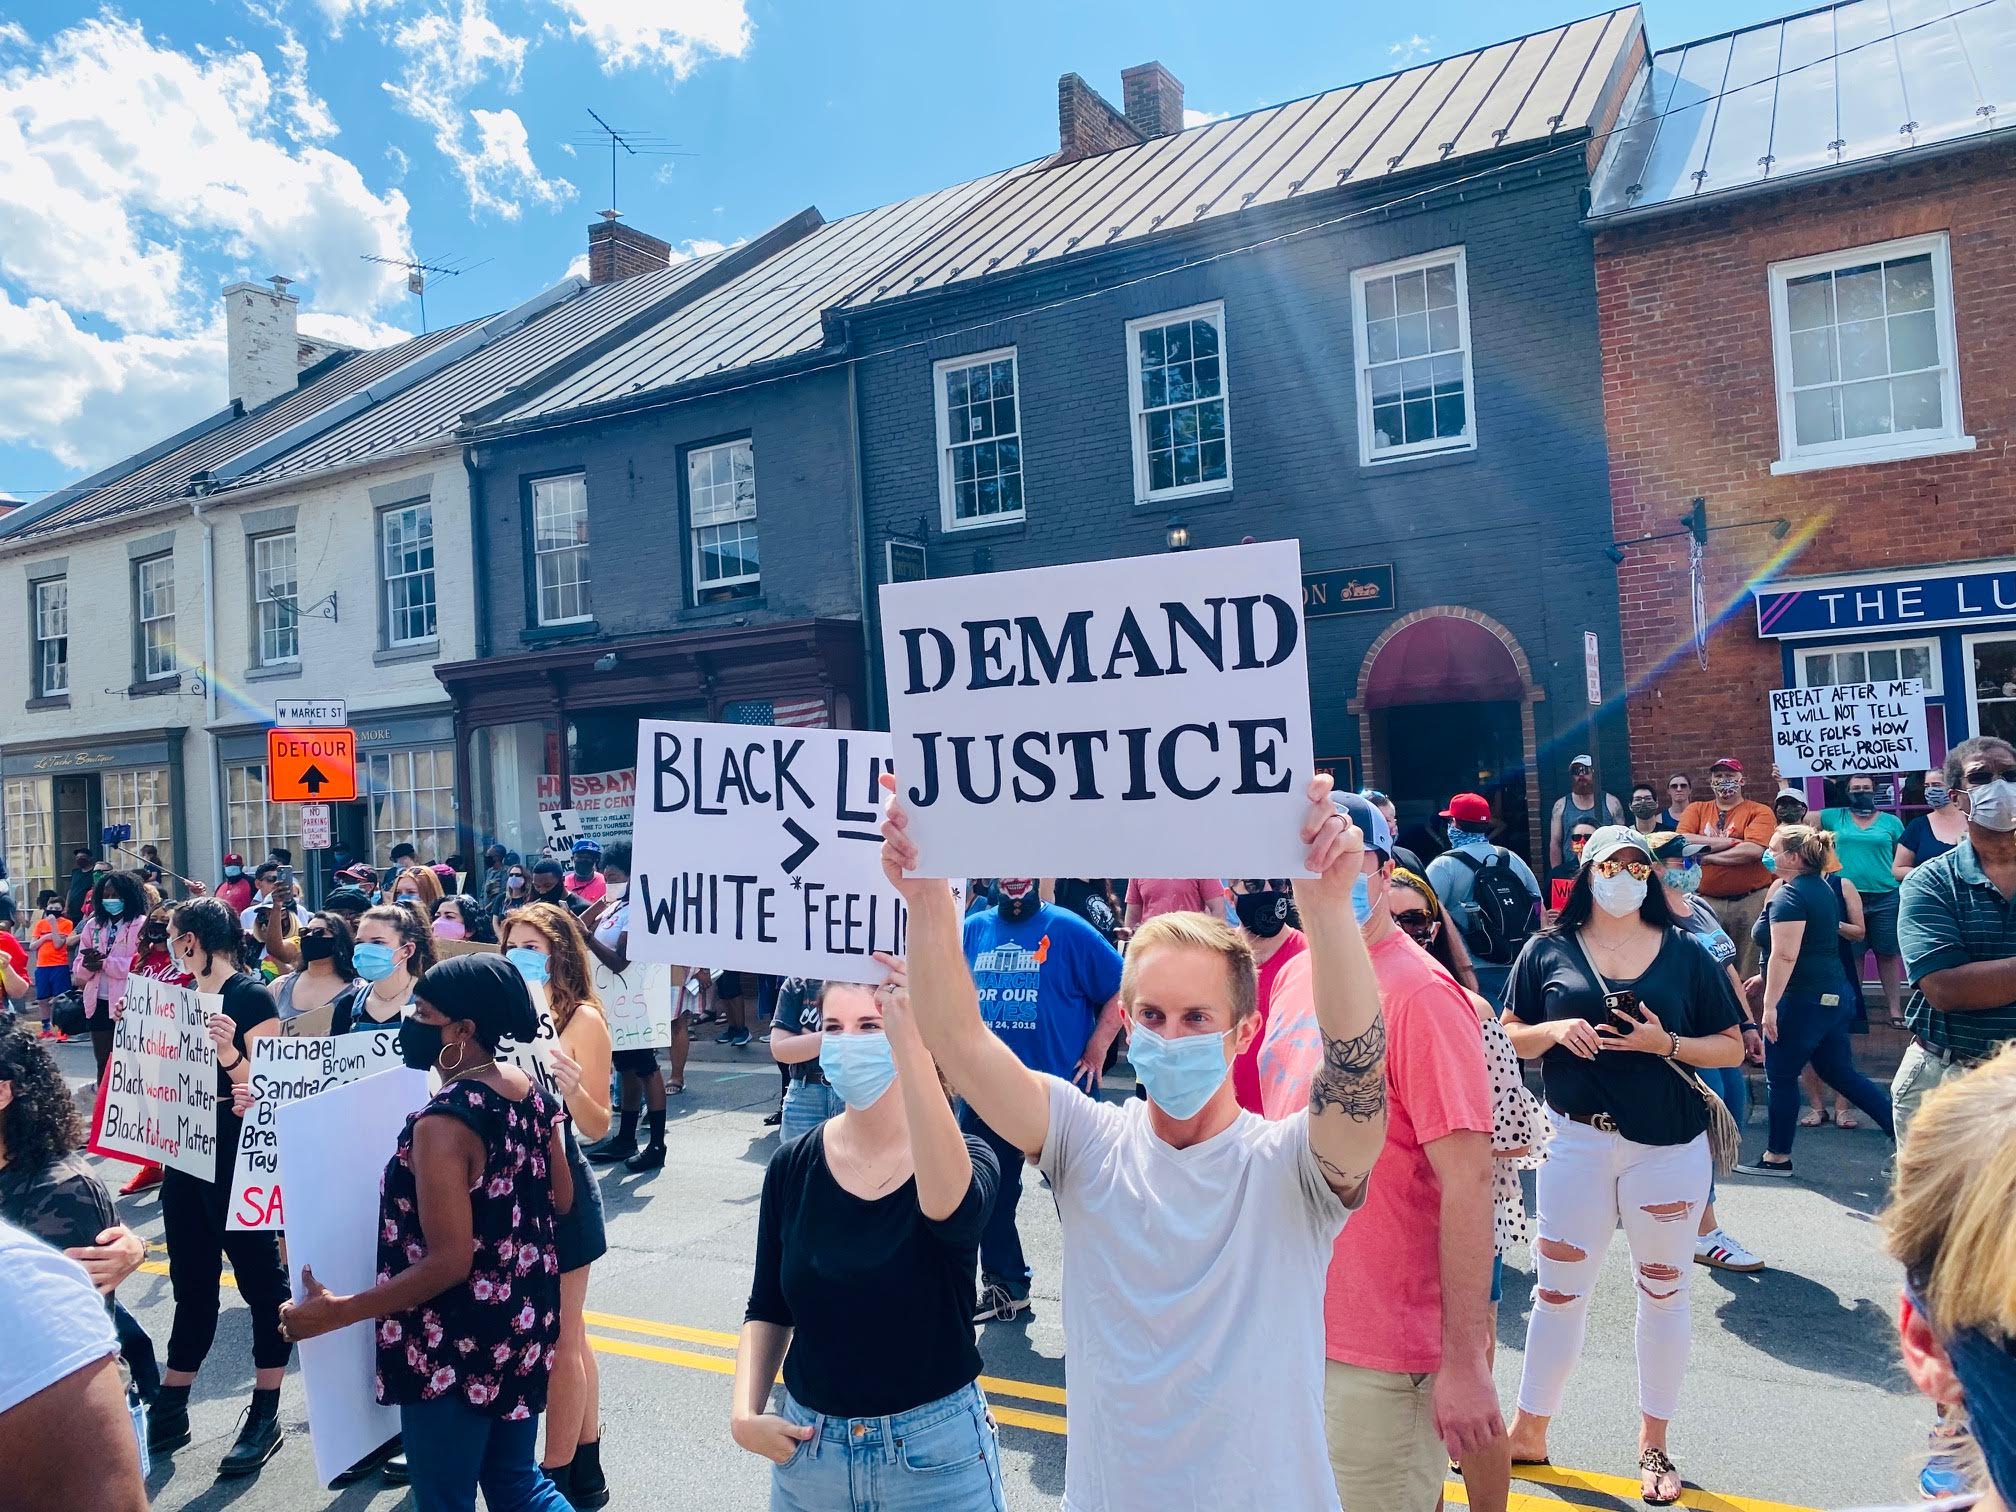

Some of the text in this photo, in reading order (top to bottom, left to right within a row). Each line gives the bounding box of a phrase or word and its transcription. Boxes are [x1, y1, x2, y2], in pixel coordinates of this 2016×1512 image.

[1818, 586, 1925, 624] THE
[898, 593, 1299, 696] DEMAND
[1773, 681, 1920, 711] REPEAT AFTER ME:
[278, 707, 342, 718] W MARKET ST
[1781, 703, 1909, 725] I WILL NOT TELL
[362, 729, 391, 741] MORE
[1777, 720, 1909, 746] BLACK FOLKS HOW
[277, 742, 346, 757] DETOUR
[1795, 744, 1814, 759] TO
[1819, 742, 1856, 758] FEEL,
[654, 731, 816, 815] BLACK
[908, 717, 1293, 808] JUSTICE
[1811, 754, 1899, 772] OR MOURN
[551, 813, 566, 831] I
[640, 871, 778, 943] WHITE
[154, 990, 176, 1019] lives
[1002, 988, 1039, 1002] OUR
[979, 1000, 1038, 1021] IVES
[995, 1021, 1010, 1030] 24,
[1012, 1021, 1036, 1030] 2018
[115, 1017, 216, 1067] Black children Matter
[256, 1038, 336, 1062] Michael
[322, 1054, 366, 1076] Brown
[112, 1061, 215, 1112] Black women Matter
[251, 1074, 320, 1101] Sandra
[105, 1104, 215, 1158] Black futures Matter
[241, 1151, 278, 1173] Tay
[236, 1184, 284, 1227] SA
